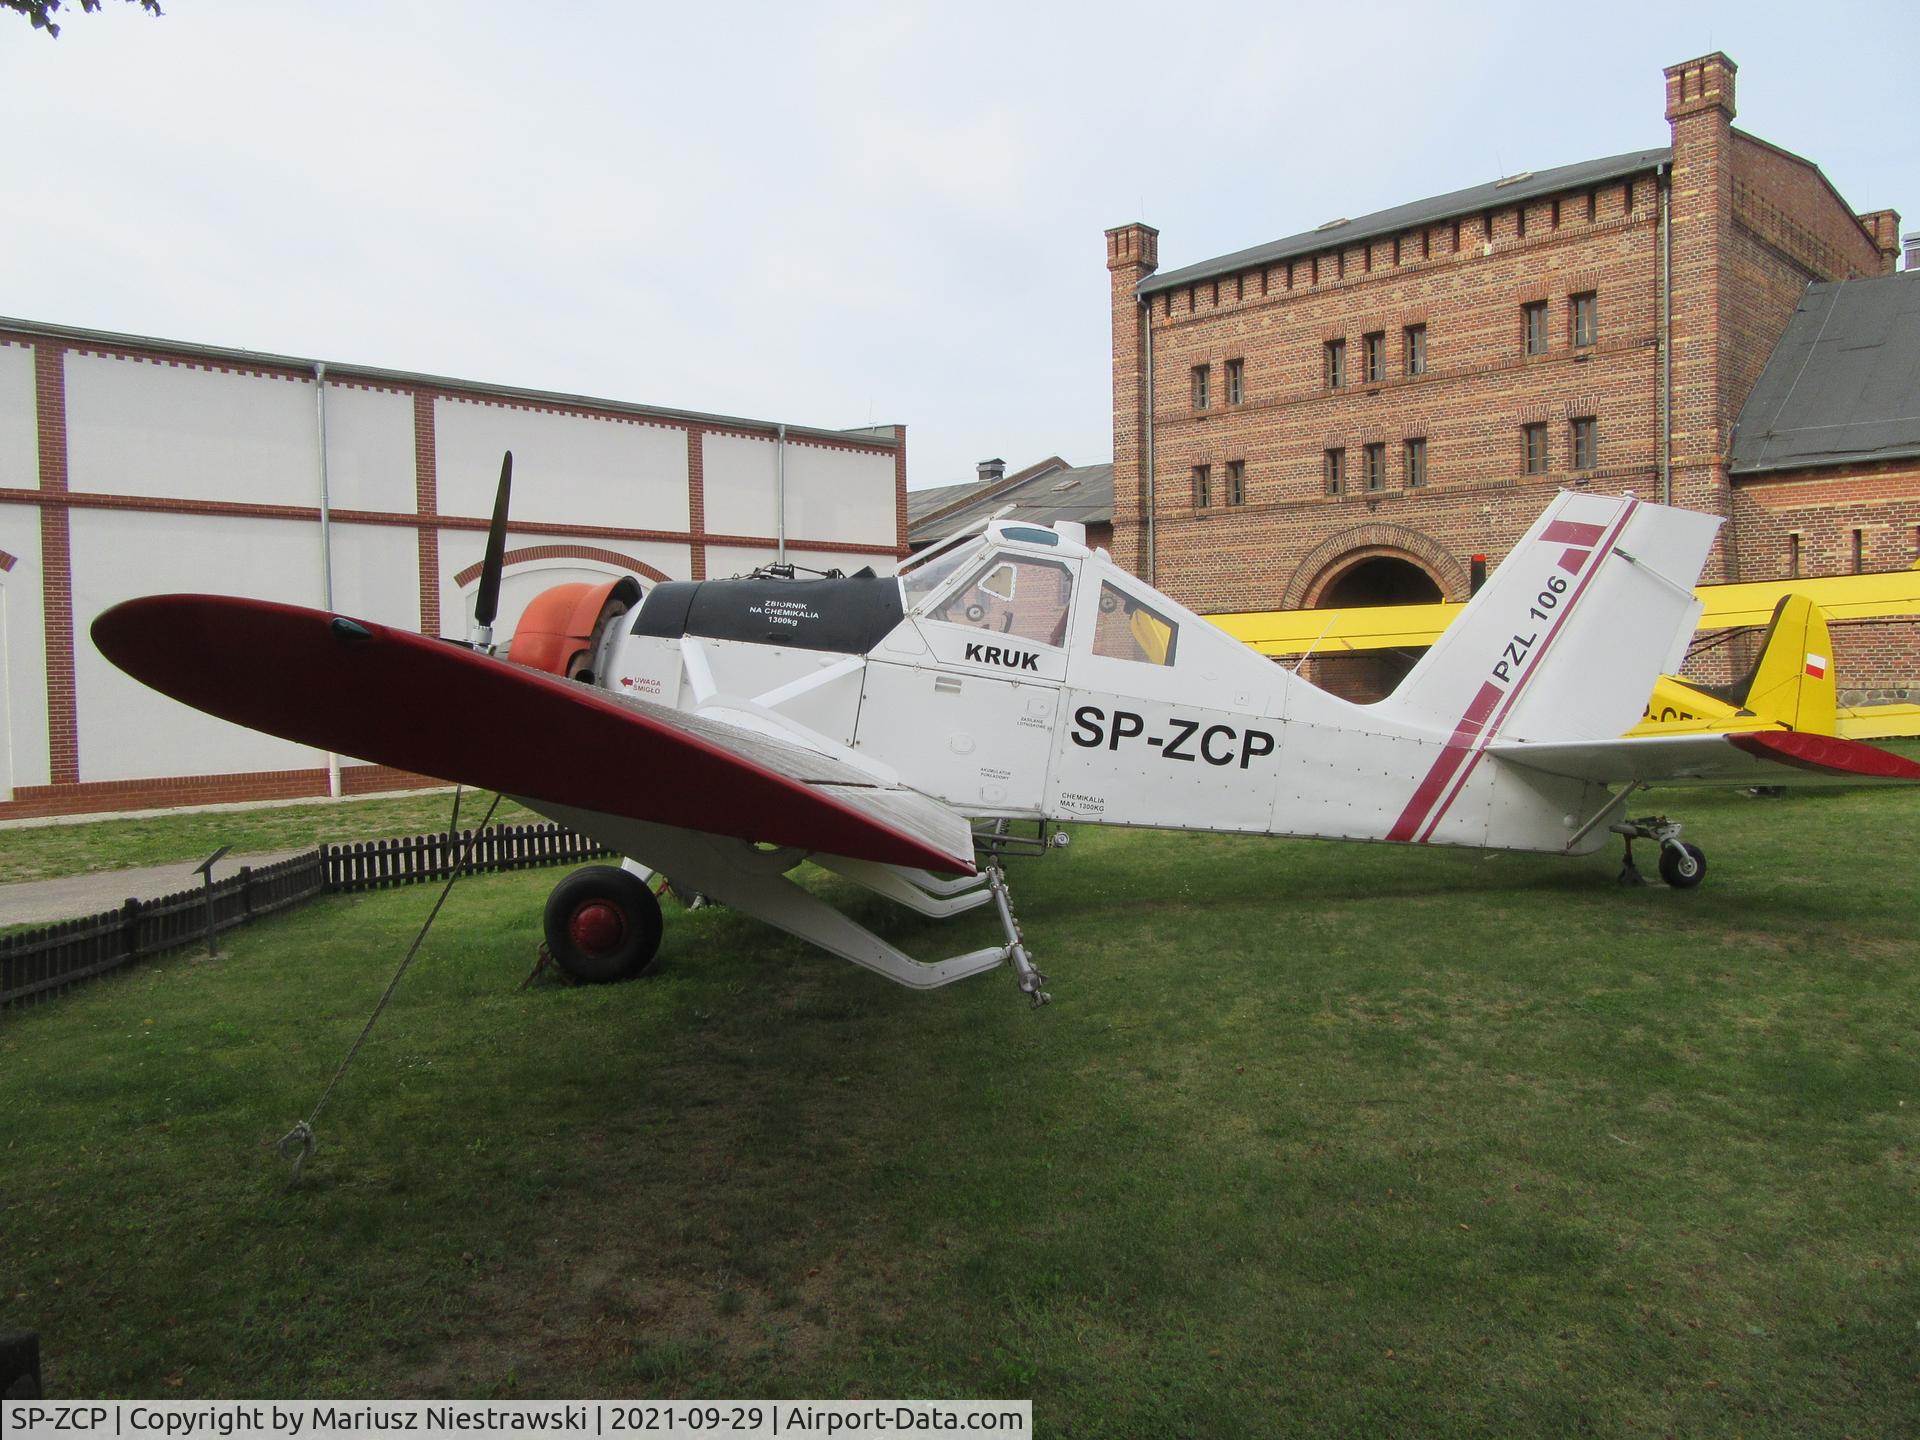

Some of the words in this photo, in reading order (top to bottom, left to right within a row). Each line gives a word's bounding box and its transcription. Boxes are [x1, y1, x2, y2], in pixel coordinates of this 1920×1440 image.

[764, 600, 807, 610] ZBIORNIK
[764, 608, 819, 619] CHEMIKALIA
[768, 616, 798, 627] 1300kg
[1492, 633, 1537, 683] PZL
[1530, 575, 1567, 620] 106
[964, 642, 1040, 672] KRUK
[634, 677, 661, 686] UWAGA
[1070, 706, 1275, 769] SP-ZCP
[1061, 792, 1105, 804] CHEMIKALIA
[1079, 803, 1104, 812] 1300KG
